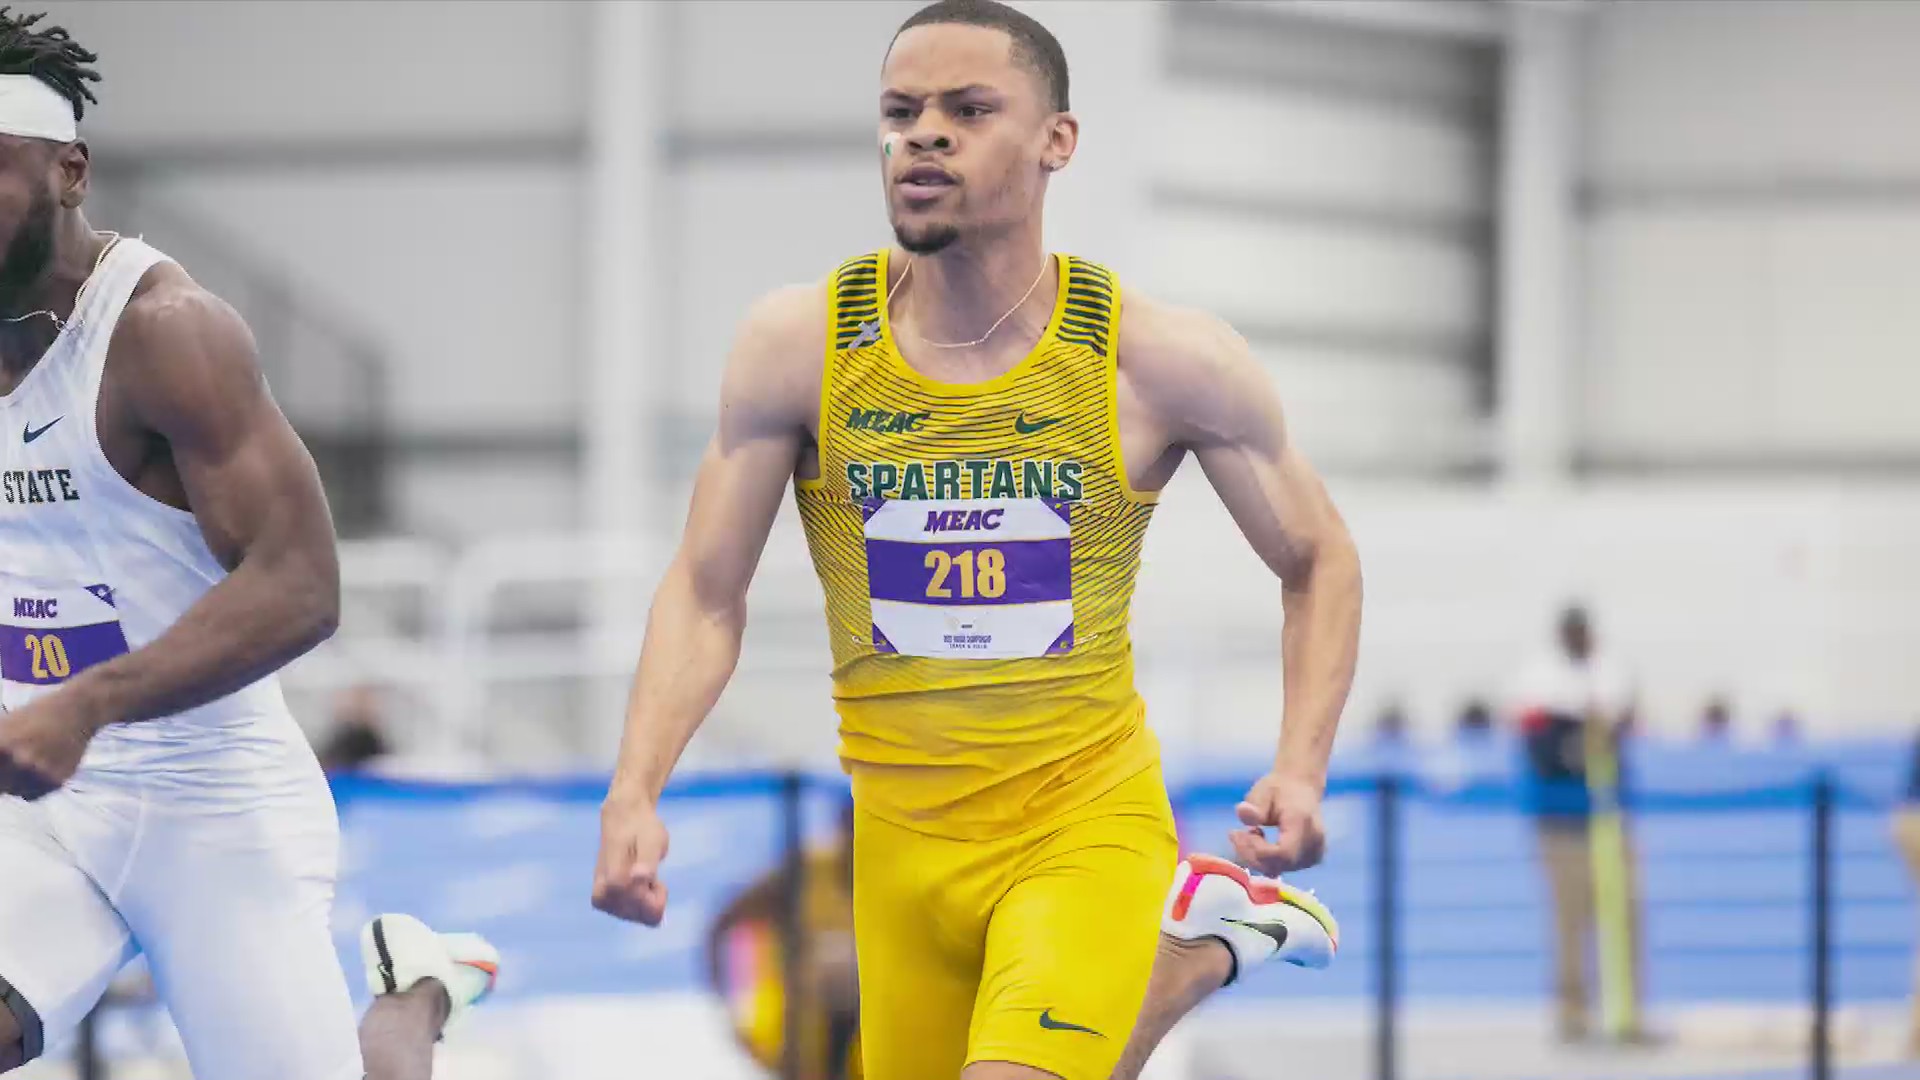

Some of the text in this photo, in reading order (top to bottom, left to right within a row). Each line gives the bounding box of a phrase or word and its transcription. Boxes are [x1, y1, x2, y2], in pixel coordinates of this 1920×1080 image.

[847, 408, 930, 433] MEAC
[3, 469, 80, 503] STATE
[846, 459, 1084, 501] SPARTANS
[924, 508, 1005, 534] MEAC
[924, 549, 1006, 598] 218
[13, 597, 58, 618] MEAC
[25, 634, 70, 679] 20
